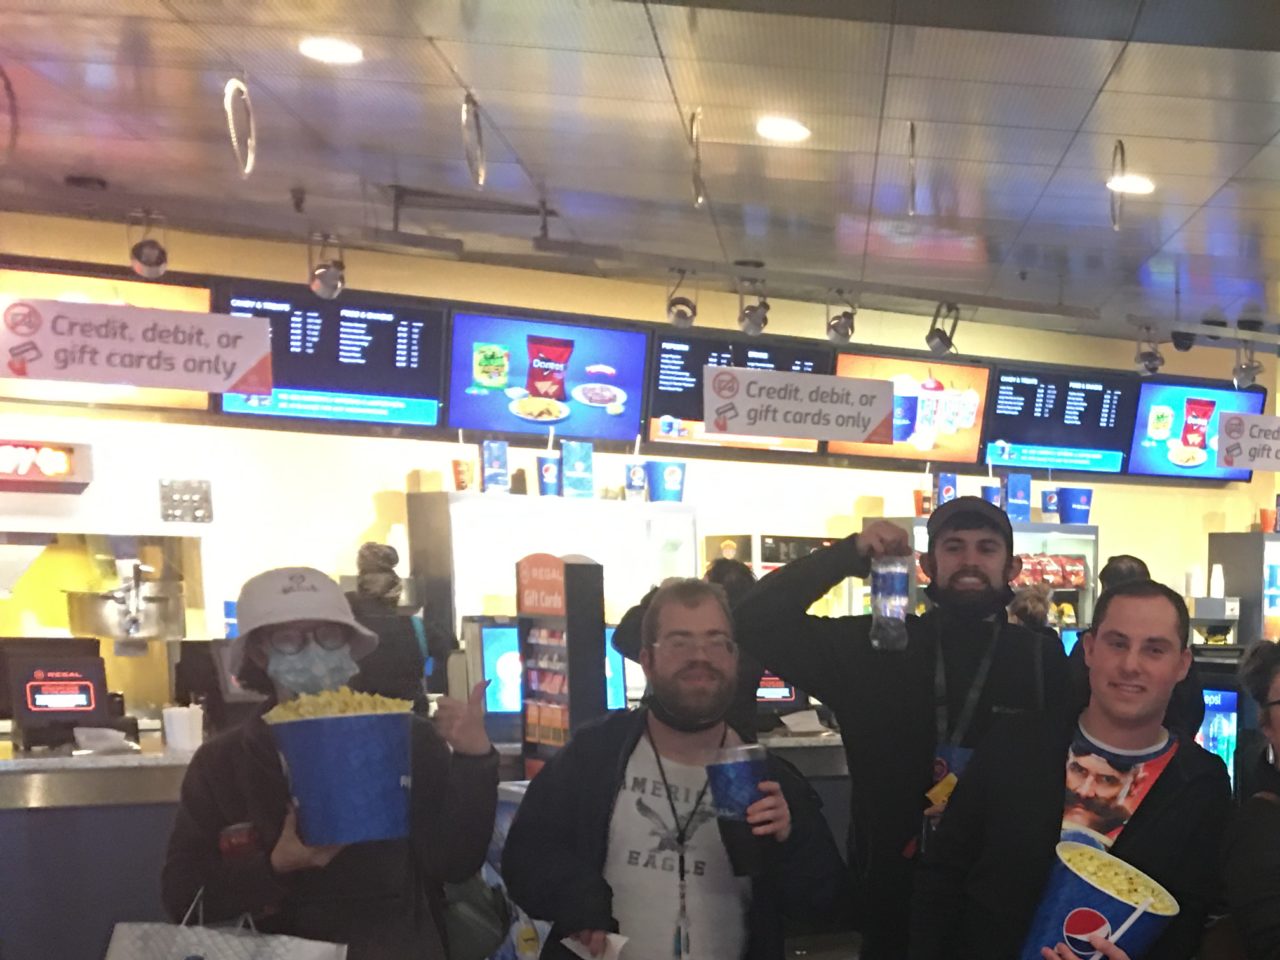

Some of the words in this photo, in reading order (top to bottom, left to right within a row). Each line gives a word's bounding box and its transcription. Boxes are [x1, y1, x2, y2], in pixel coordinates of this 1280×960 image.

[51, 314, 134, 342] Credit,
[142, 322, 209, 349] debit,
[217, 331, 243, 349] or
[54, 343, 98, 370] gift
[106, 349, 175, 371] cards
[183, 355, 237, 380] only
[746, 380, 803, 402] Credit,
[808, 385, 854, 406] debit,
[859, 392, 877, 407] or
[746, 404, 778, 426] gift
[783, 408, 830, 426] cards
[836, 412, 872, 433] only
[1248, 445, 1272, 462] gift
[1204, 694, 1221, 707] epsi
[622, 776, 711, 804] MERI
